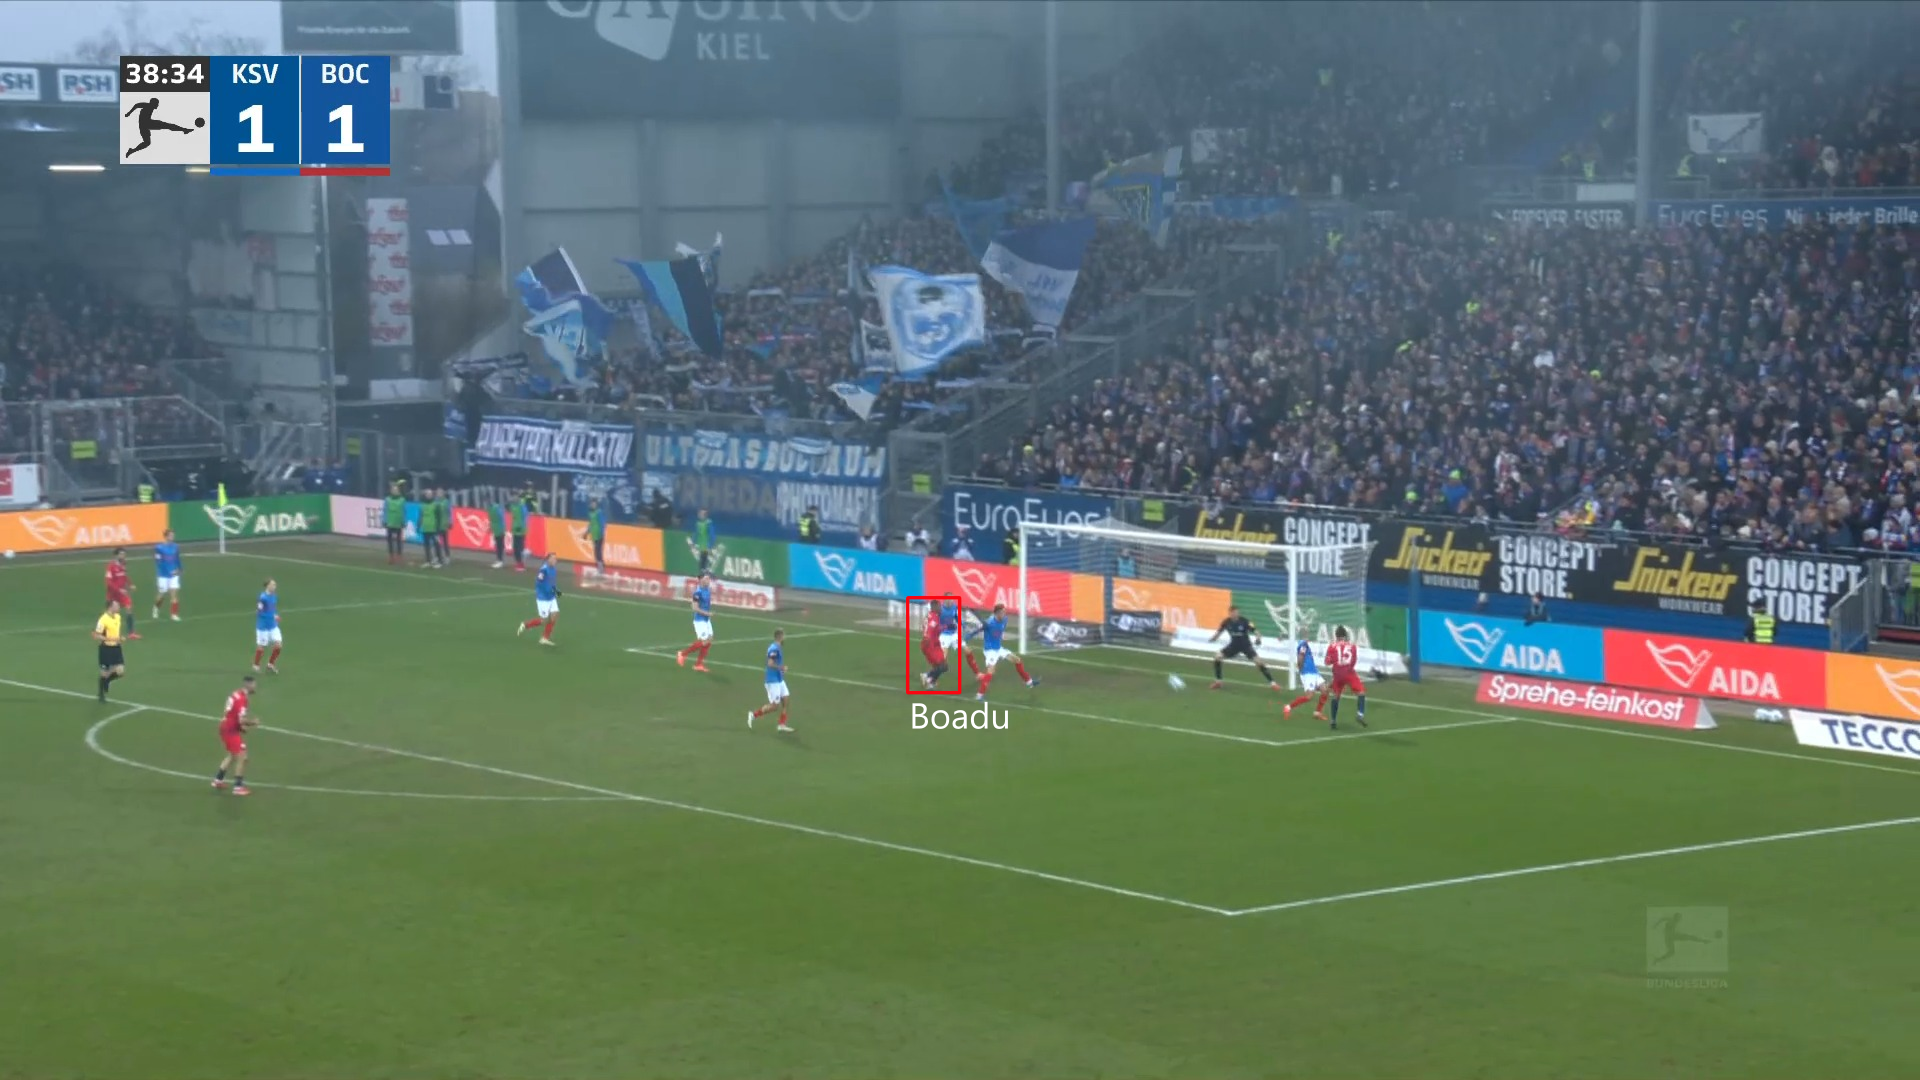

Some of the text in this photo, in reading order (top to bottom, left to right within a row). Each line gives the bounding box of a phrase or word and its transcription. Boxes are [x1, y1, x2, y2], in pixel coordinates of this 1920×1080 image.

[697, 33, 770, 60] KIEL
[0, 73, 34, 90] SH
[62, 75, 113, 92] RSH
[254, 512, 307, 533] AIDA
[954, 493, 1099, 547] EuroEyes
[1284, 517, 1371, 549] CONCEPT
[75, 524, 132, 546] AIDA
[1285, 547, 1349, 576] TORE.
[1384, 526, 1492, 577] Snickers
[1500, 535, 1597, 571] CONCEPT
[722, 556, 764, 580] AIDA
[1613, 546, 1739, 600] Snickers
[1747, 556, 1862, 596] CONCEPT
[684, 578, 767, 608] Btano
[853, 570, 897, 595] AIDA
[1423, 574, 1480, 591] WORKWEAR
[995, 587, 1041, 613] AIA
[1658, 597, 1724, 616] WORKWEAR
[1150, 606, 1198, 628] IDA
[1336, 645, 1353, 665] 15
[1501, 643, 1564, 674] AIDA
[1708, 666, 1781, 700] AIDA
[1487, 674, 1685, 722] Sprehe-feinkost
